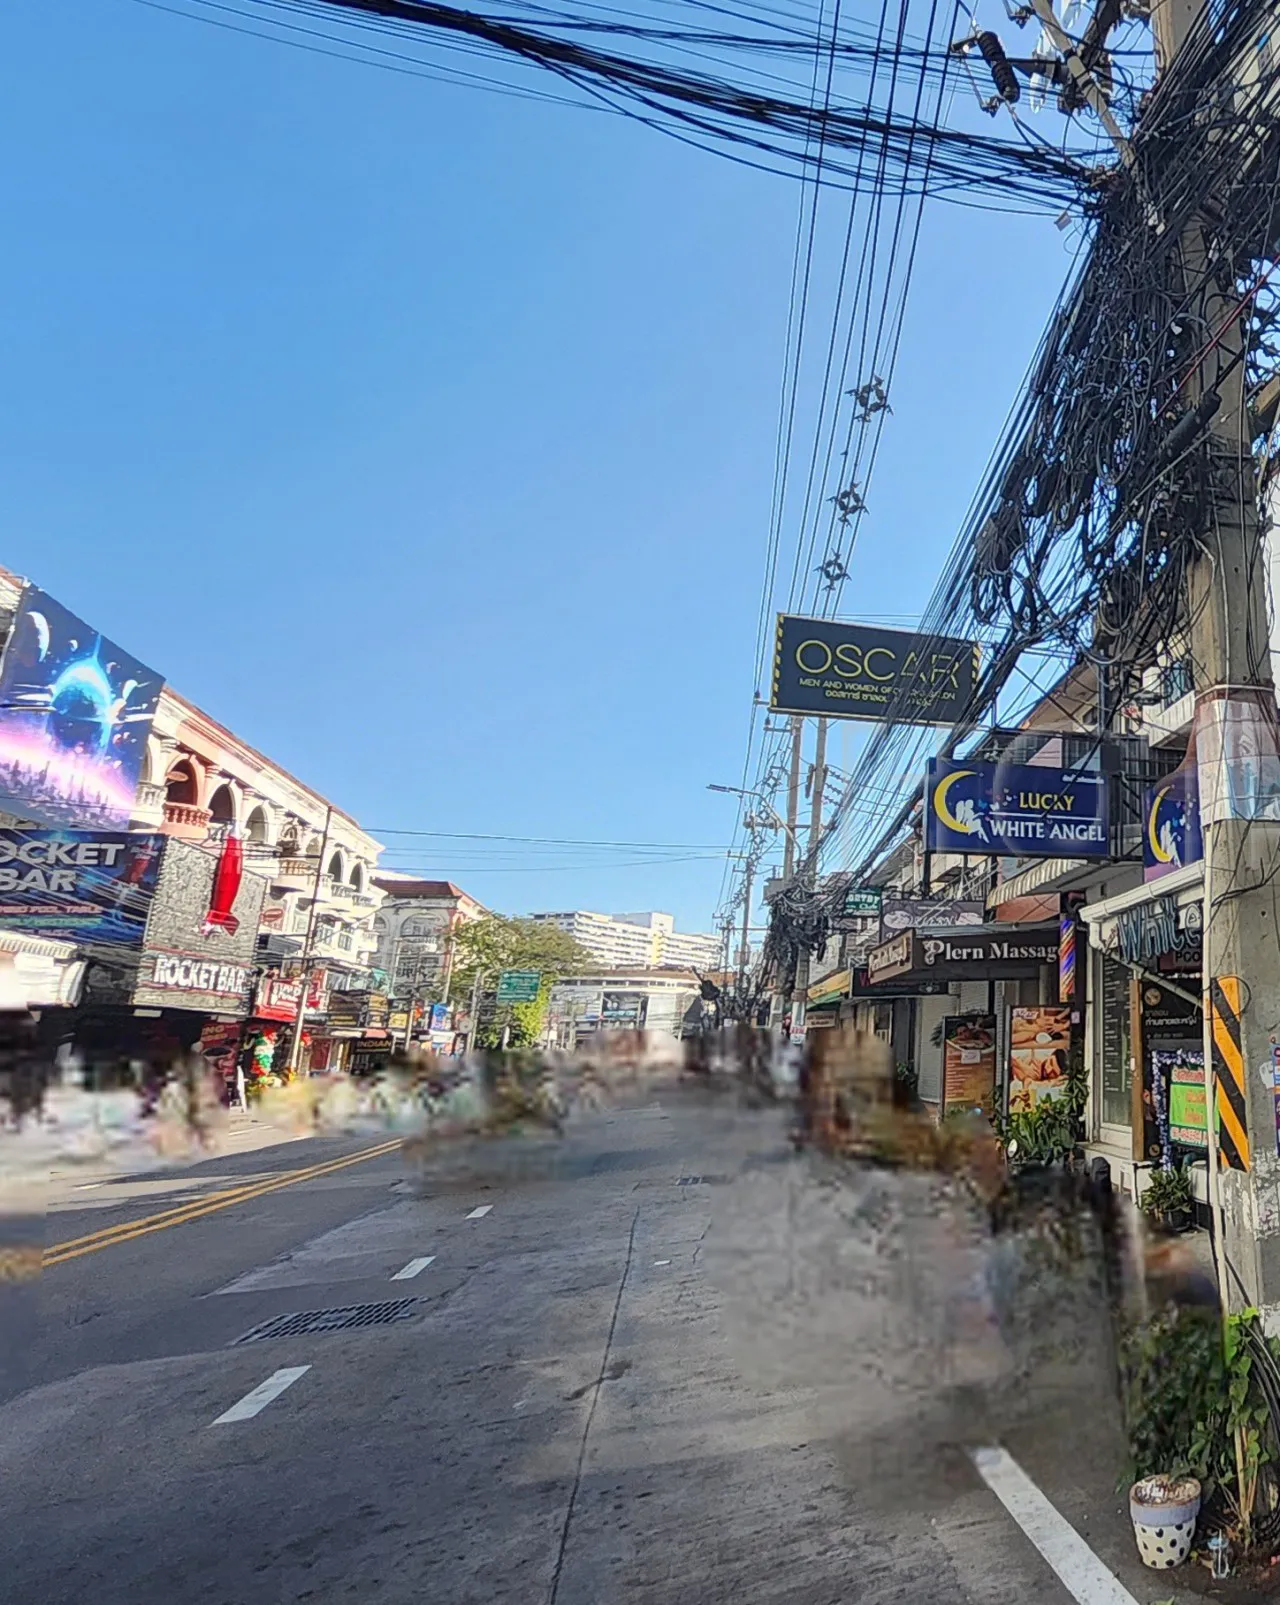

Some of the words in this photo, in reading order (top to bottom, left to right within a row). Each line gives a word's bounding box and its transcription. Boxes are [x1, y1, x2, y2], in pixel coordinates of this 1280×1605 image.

[795, 639, 959, 689] OSCAR
[799, 676, 821, 687] MEN
[822, 679, 843, 690] AND
[844, 682, 879, 694] WOMEN
[1019, 791, 1075, 811] LUCKY
[990, 819, 1046, 839] WHITE
[1049, 823, 1106, 842] ANGEL
[0, 867, 77, 892] BAR
[1117, 895, 1203, 965] White
[922, 938, 984, 966] Plern
[153, 954, 219, 991] ROCKET
[218, 964, 248, 995] BAR
